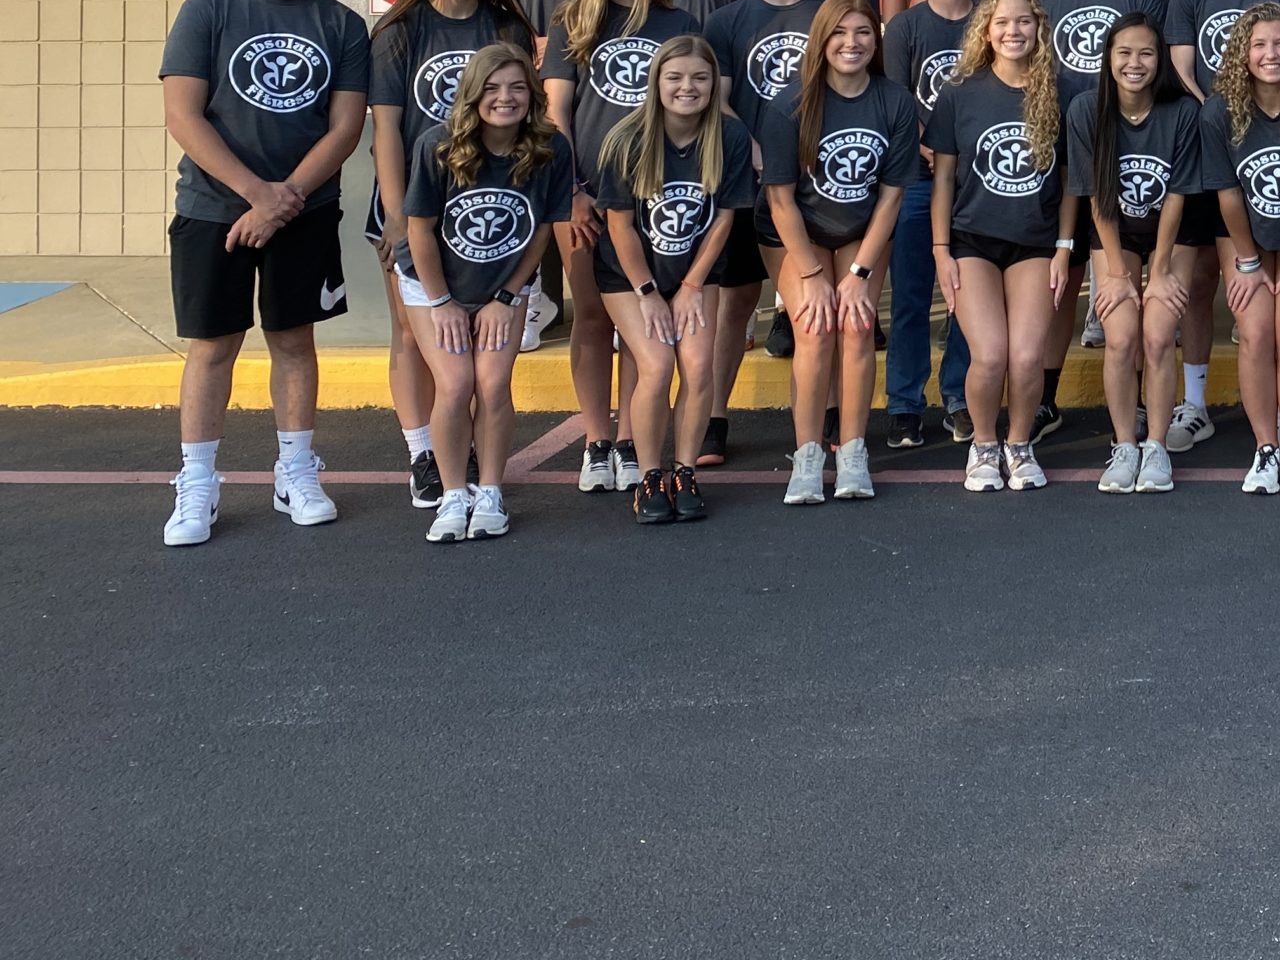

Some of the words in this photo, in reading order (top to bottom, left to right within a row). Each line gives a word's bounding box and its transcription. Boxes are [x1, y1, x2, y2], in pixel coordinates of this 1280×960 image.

[1061, 8, 1116, 34] absolut
[243, 37, 320, 67] absolute
[598, 40, 660, 61] absolut
[756, 35, 808, 62] absolut
[245, 84, 315, 108] fitness
[818, 132, 883, 161] absolute
[449, 193, 526, 217] absolute
[646, 186, 708, 210] absolut
[450, 237, 520, 258] fitness
